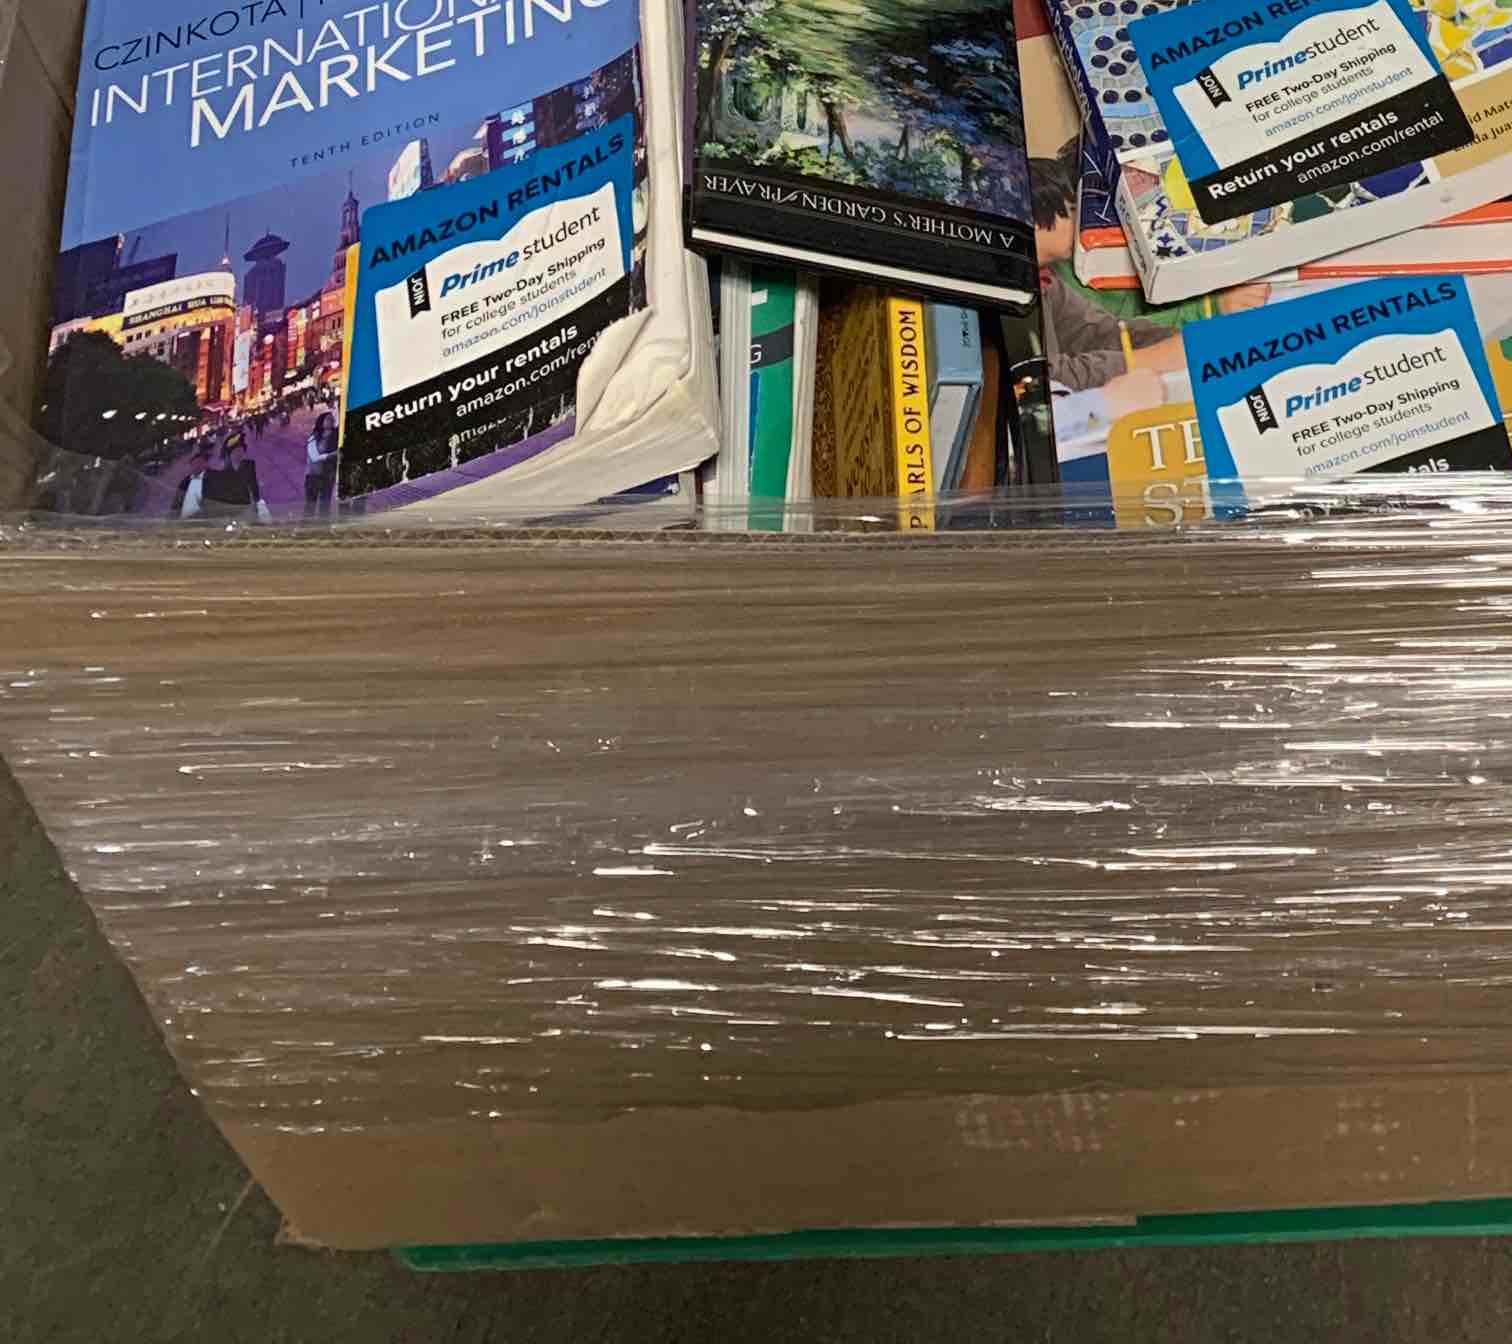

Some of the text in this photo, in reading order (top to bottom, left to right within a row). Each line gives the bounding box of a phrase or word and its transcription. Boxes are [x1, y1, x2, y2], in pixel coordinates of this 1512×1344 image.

[1149, 9, 1265, 71] AMAZON
[1244, 41, 1398, 114] FREE Two-Day Shipping
[289, 112, 441, 170] TENTH EDITION
[1206, 109, 1400, 201] Return your rentals
[1294, 111, 1446, 185] amazon.com/rental
[368, 131, 625, 269] AMAZON RENTALS
[703, 173, 1016, 249] A MOTHER'S GARDEN PRAYER
[440, 236, 607, 326] FREE Two-Day Shipping
[1200, 281, 1458, 385] AMAZON RENTALS
[364, 323, 580, 432] Return your rentals
[898, 309, 923, 435] OF WISDOM
[1291, 377, 1461, 445] FREE Two-Day Shipping
[1319, 401, 1434, 450] college students
